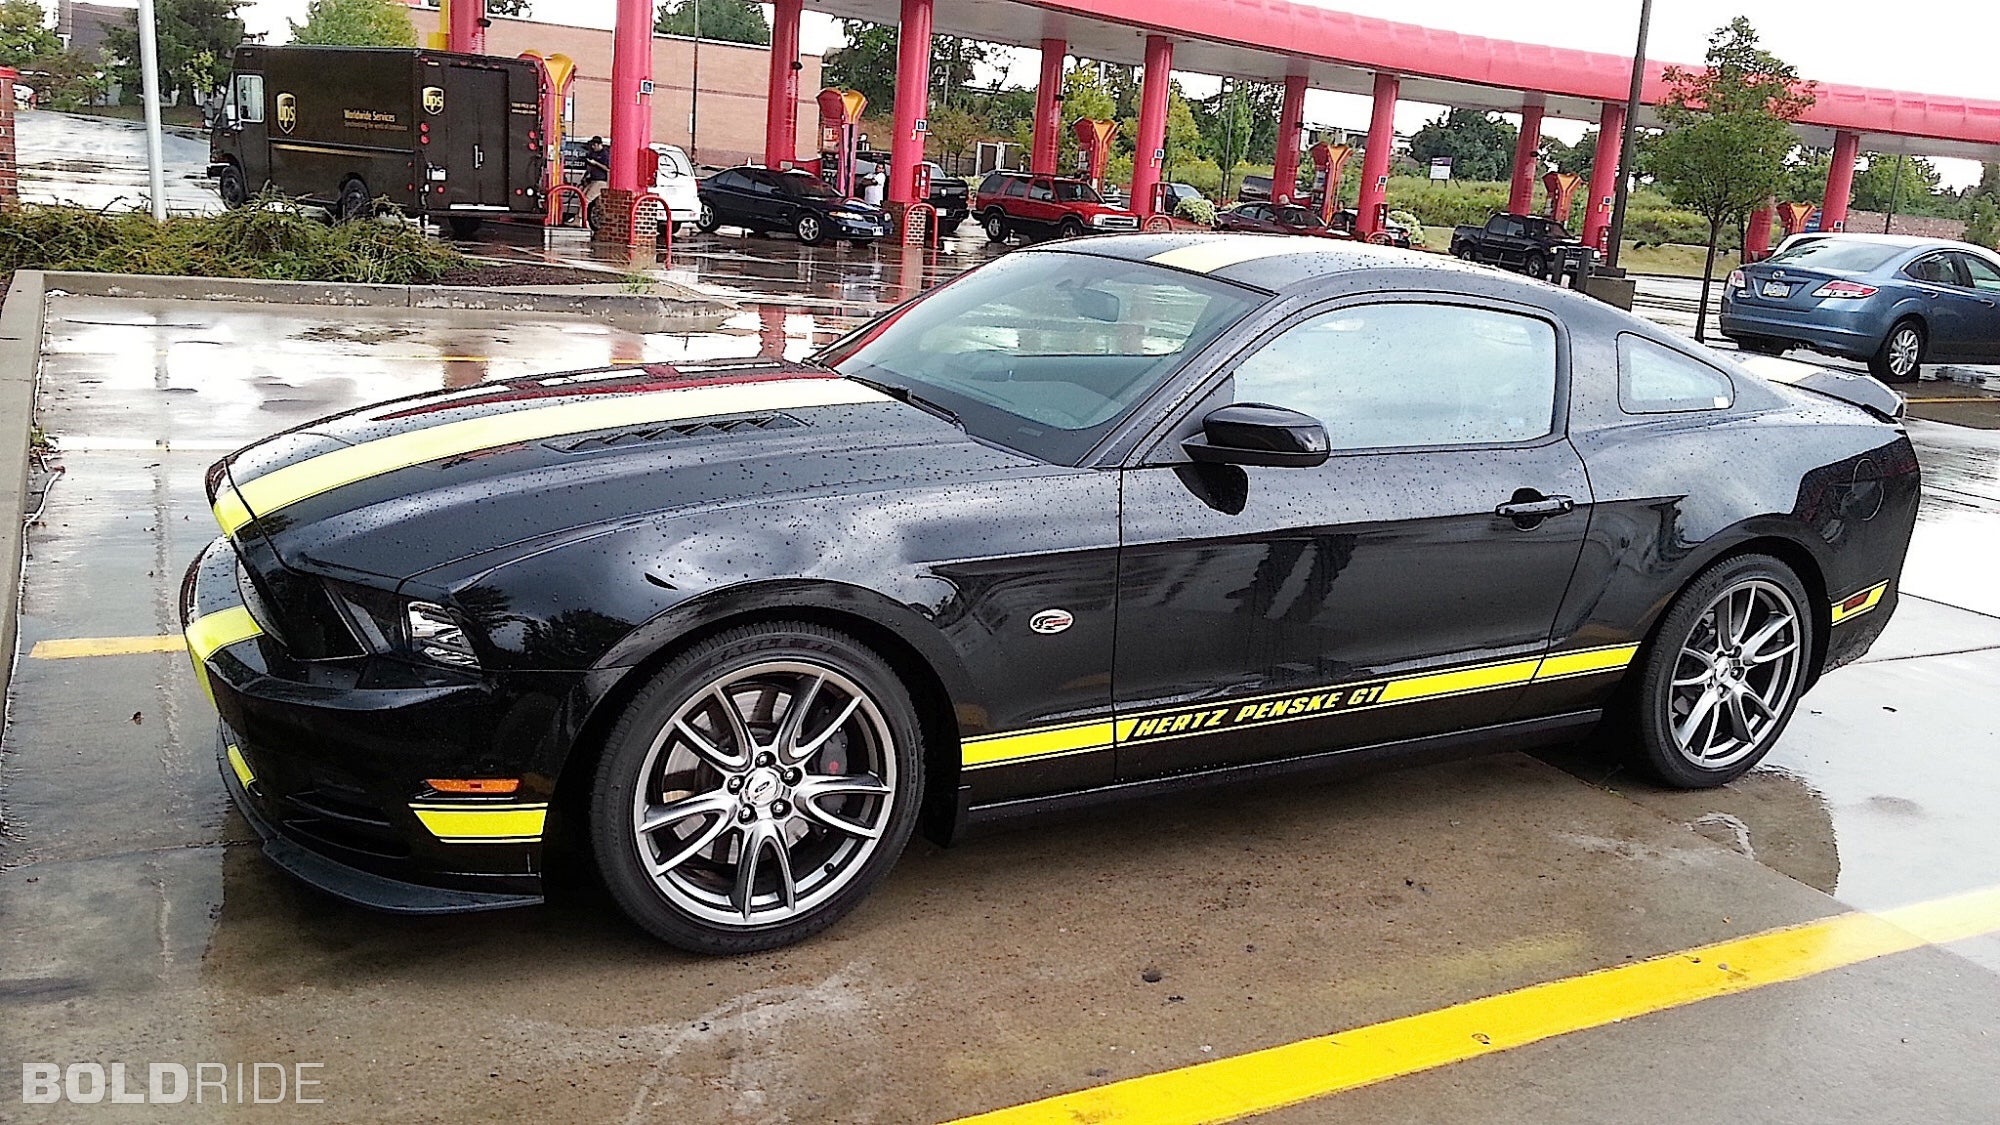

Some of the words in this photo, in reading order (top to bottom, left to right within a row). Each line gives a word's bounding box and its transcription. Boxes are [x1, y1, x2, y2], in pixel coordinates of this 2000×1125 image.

[343, 109, 372, 120] Worldwide
[372, 111, 395, 122] Services
[1133, 708, 1230, 738] HERTZ
[1234, 691, 1343, 723] PENSKE
[1347, 686, 1385, 706] GT
